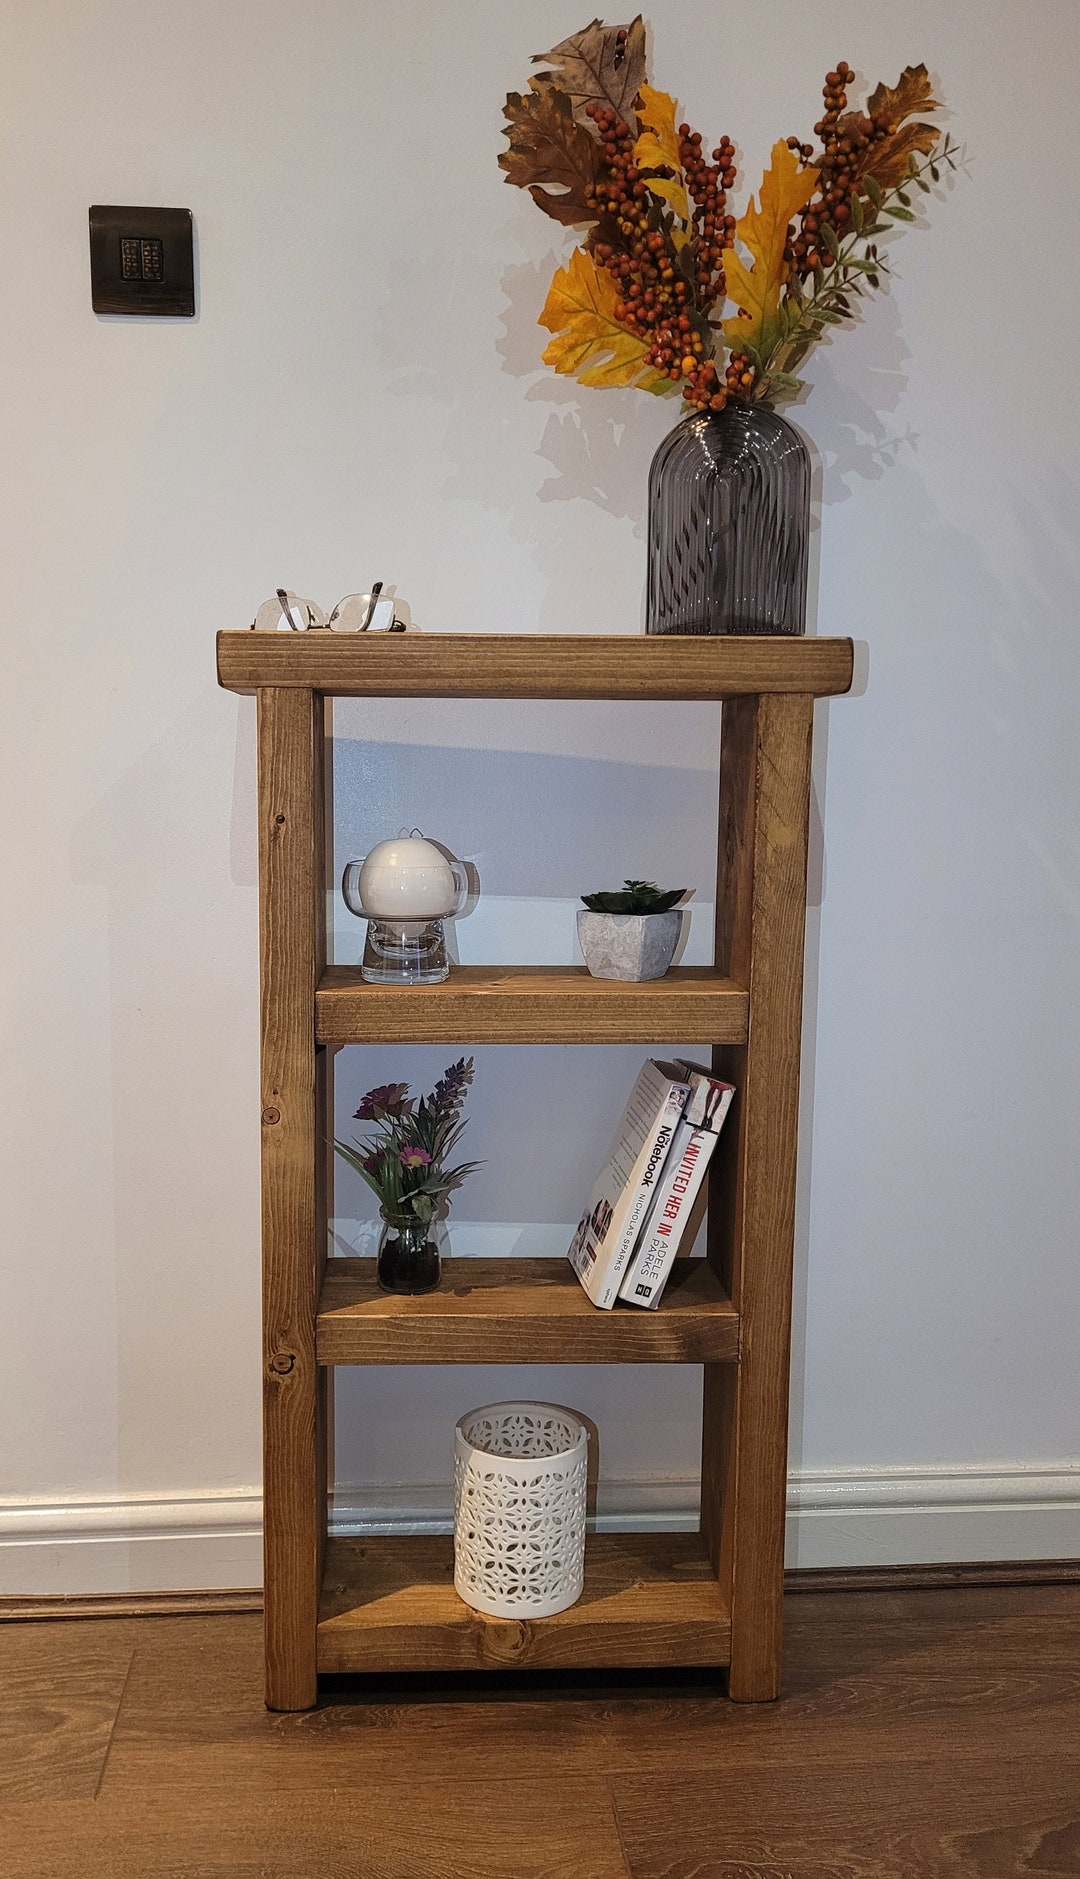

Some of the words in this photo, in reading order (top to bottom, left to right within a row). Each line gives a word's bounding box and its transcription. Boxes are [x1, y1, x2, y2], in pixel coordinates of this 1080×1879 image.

[641, 1125, 672, 1187] Notebook
[672, 1142, 701, 1194] INVITED
[626, 1193, 646, 1237] NICHOLAS
[663, 1194, 682, 1220] HER
[656, 1222, 673, 1237] IN
[613, 1238, 630, 1272] SPARKS
[640, 1238, 660, 1276] PARKS
[649, 1240, 669, 1280] ADELE
